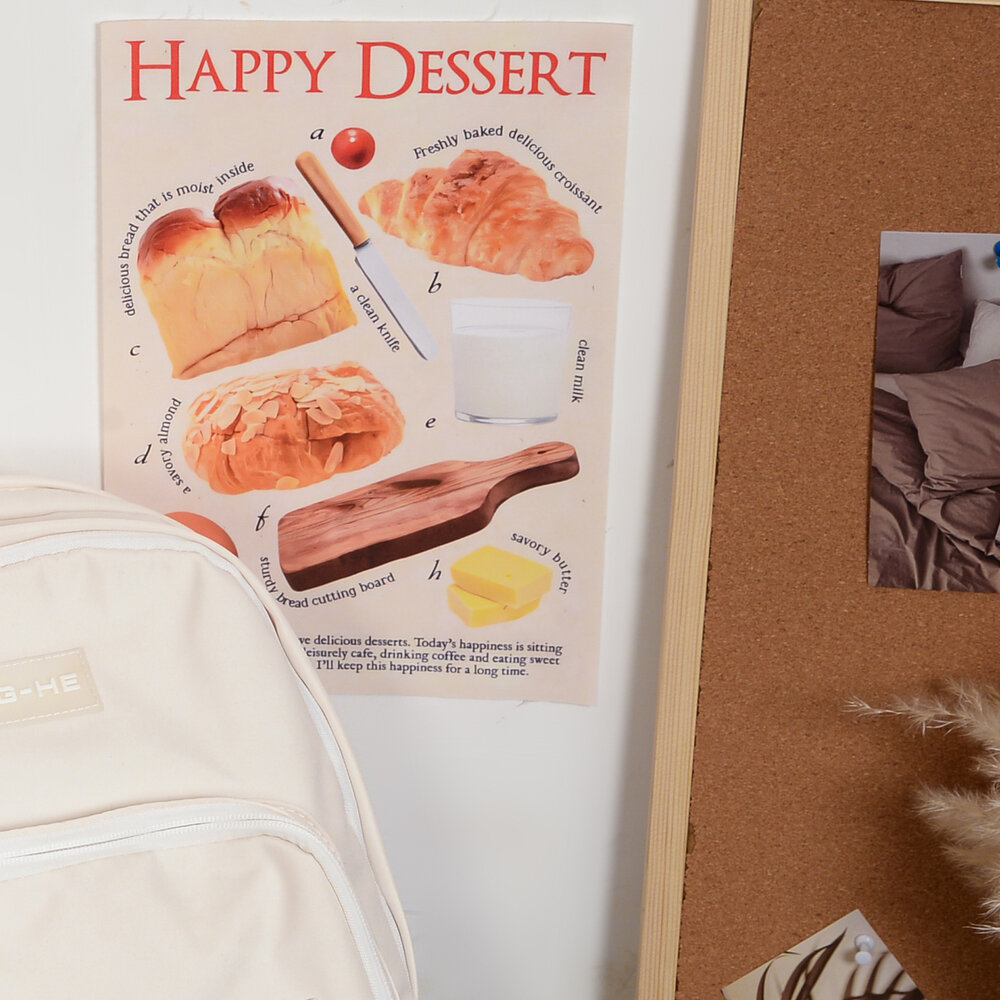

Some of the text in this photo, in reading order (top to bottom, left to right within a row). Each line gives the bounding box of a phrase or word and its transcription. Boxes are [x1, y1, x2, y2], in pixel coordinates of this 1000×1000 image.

[124, 40, 607, 101] HAPPY DESSERT
[310, 128, 325, 141] a
[413, 125, 604, 215] Freshly baked delicious croissant
[118, 161, 255, 316] delicious bread that is moist inside
[428, 271, 442, 294] b
[350, 285, 400, 353] a clean knife
[130, 345, 141, 357] c
[571, 339, 590, 403] clean milk
[425, 417, 437, 430] e
[134, 443, 152, 464] d
[157, 397, 192, 495] a savory almond
[255, 504, 271, 532] f
[427, 560, 443, 581] h
[510, 532, 572, 595] savory butter
[260, 556, 396, 608] sturdy bread cutting board
[298, 634, 563, 657] ve delicious desserts. Today's happiness is sitting
[350, 647, 377, 661] cafe,
[380, 648, 429, 663] drinking
[431, 650, 466, 662] coffee
[469, 652, 489, 663] and
[492, 653, 528, 667] eating
[529, 656, 560, 666] sweet
[317, 660, 529, 679] I'll keep this happiness for a long time.
